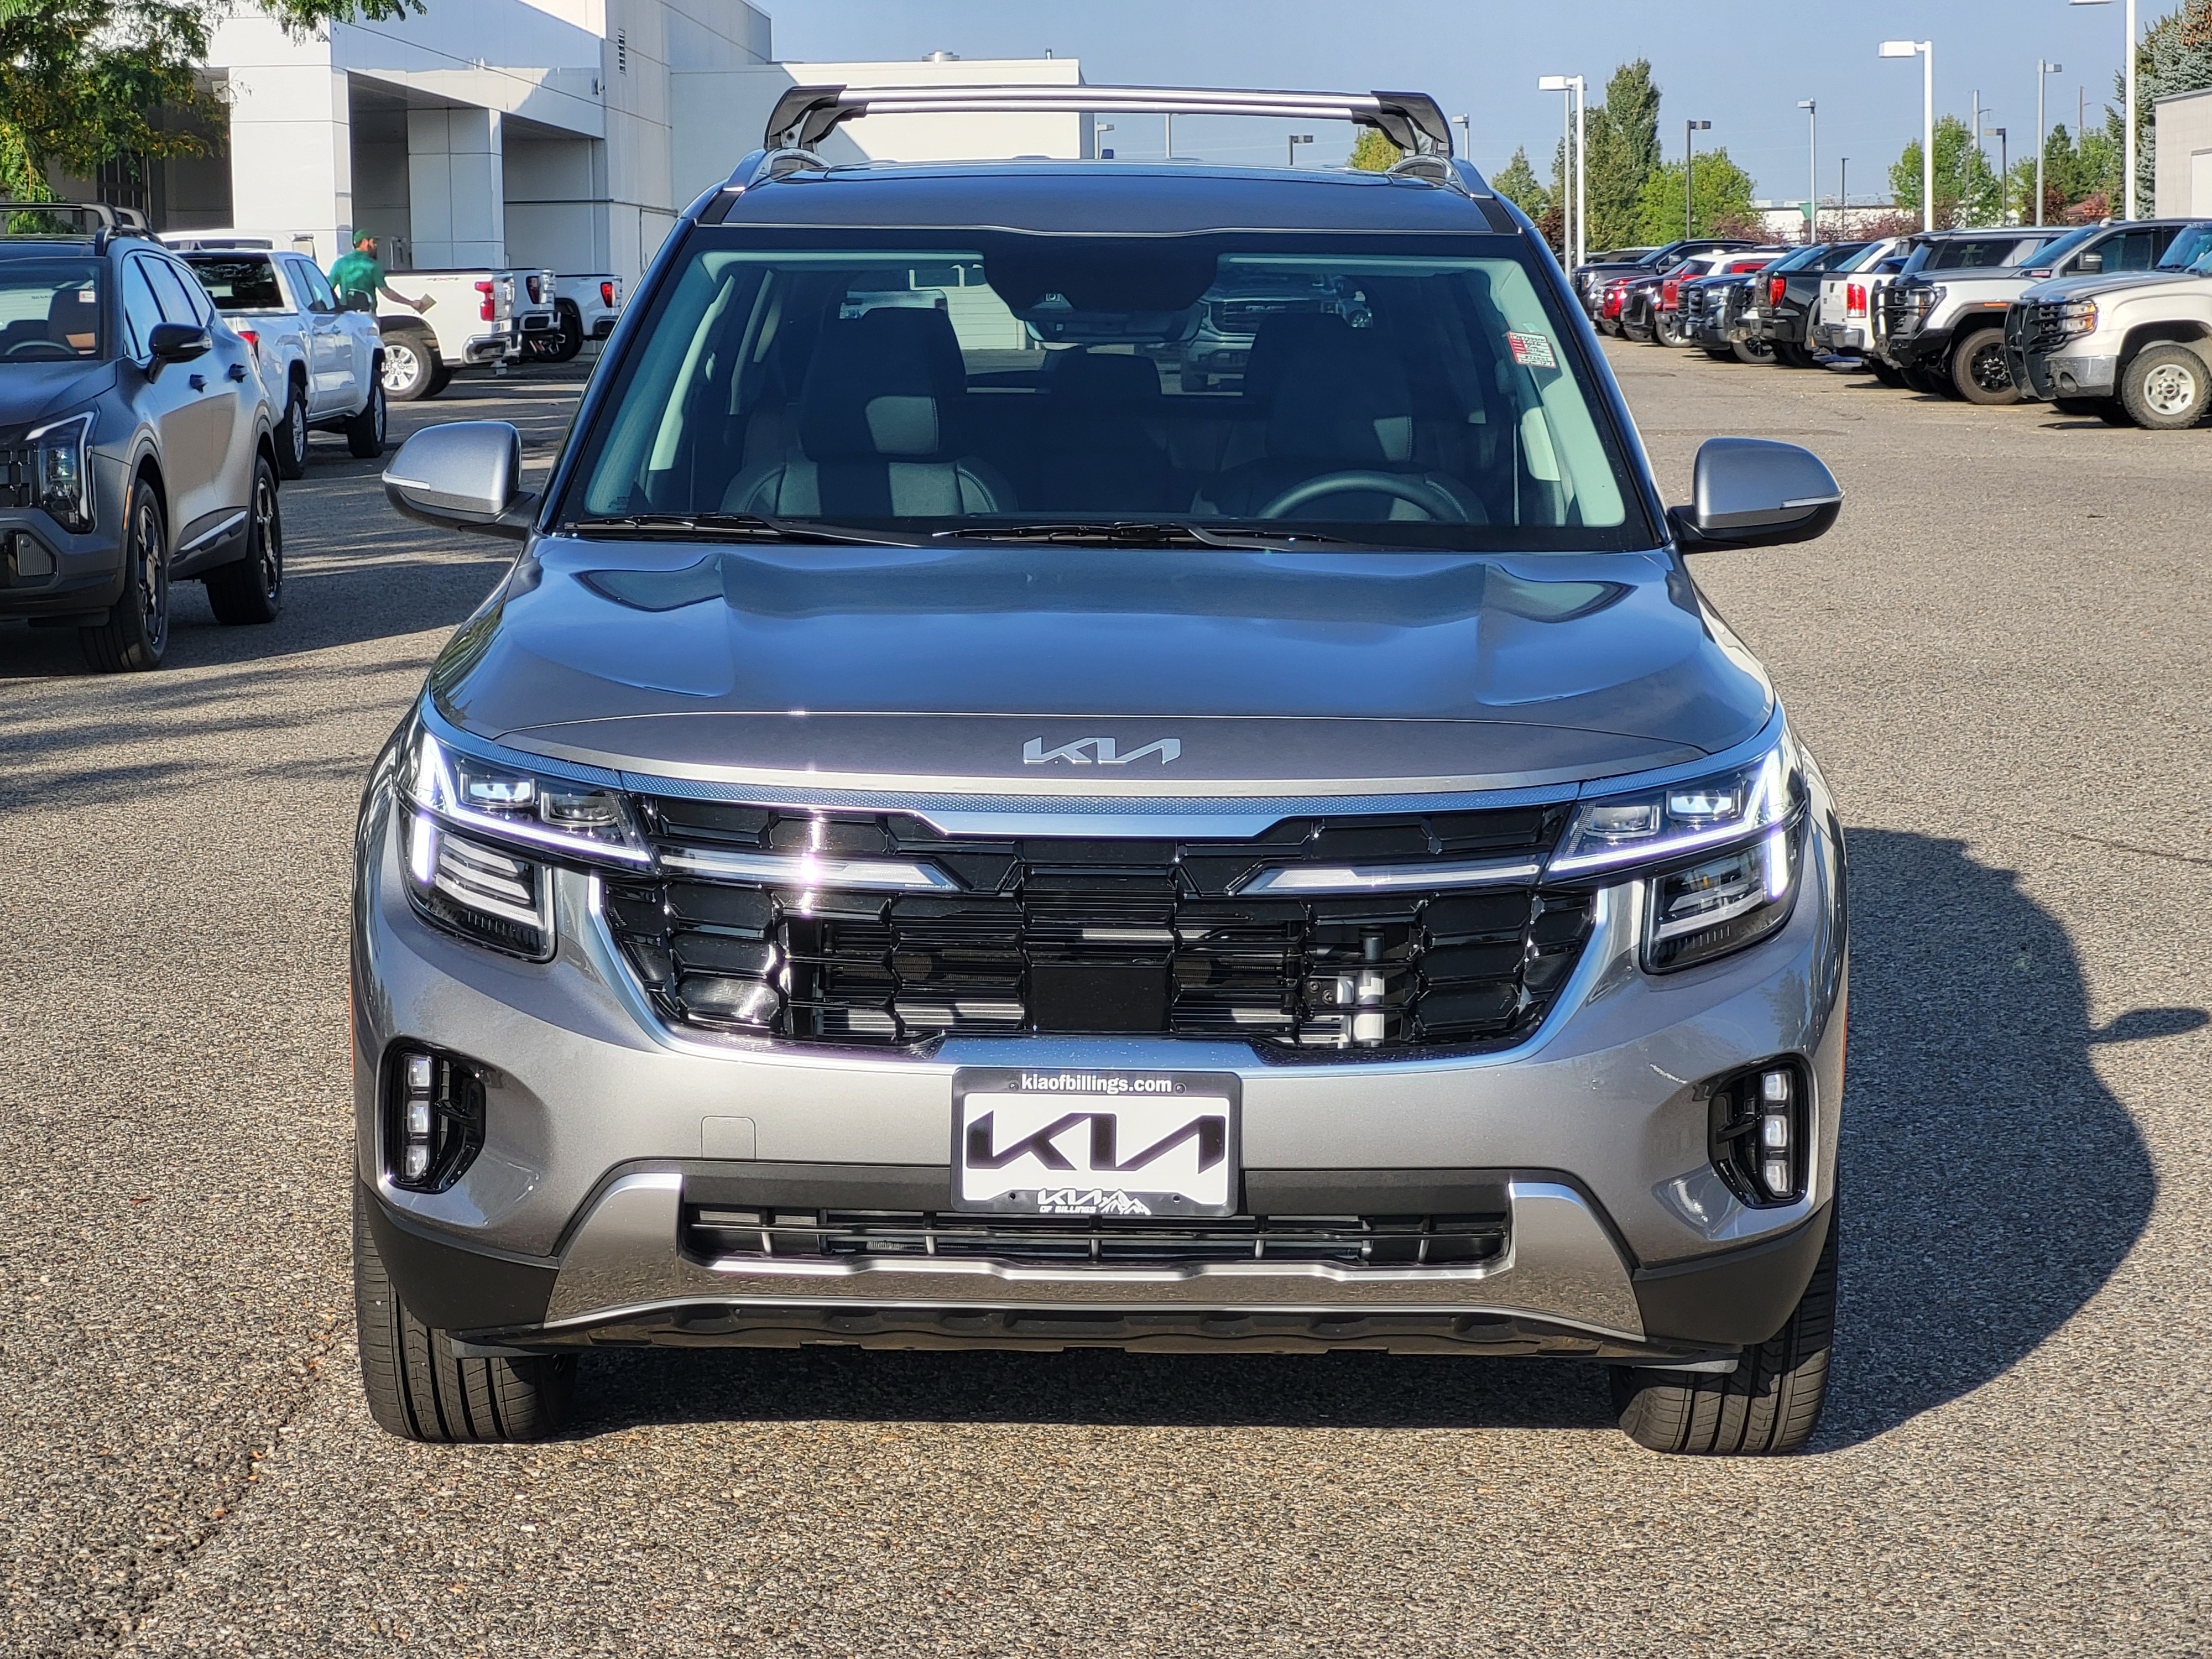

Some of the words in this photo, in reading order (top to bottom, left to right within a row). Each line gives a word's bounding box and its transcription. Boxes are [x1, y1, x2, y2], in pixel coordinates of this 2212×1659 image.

[1023, 737, 1181, 764] KIA
[1021, 1073, 1172, 1094] kiaofbillings.com
[967, 1110, 1225, 1174] KIA
[1037, 1189, 1102, 1206] KIA
